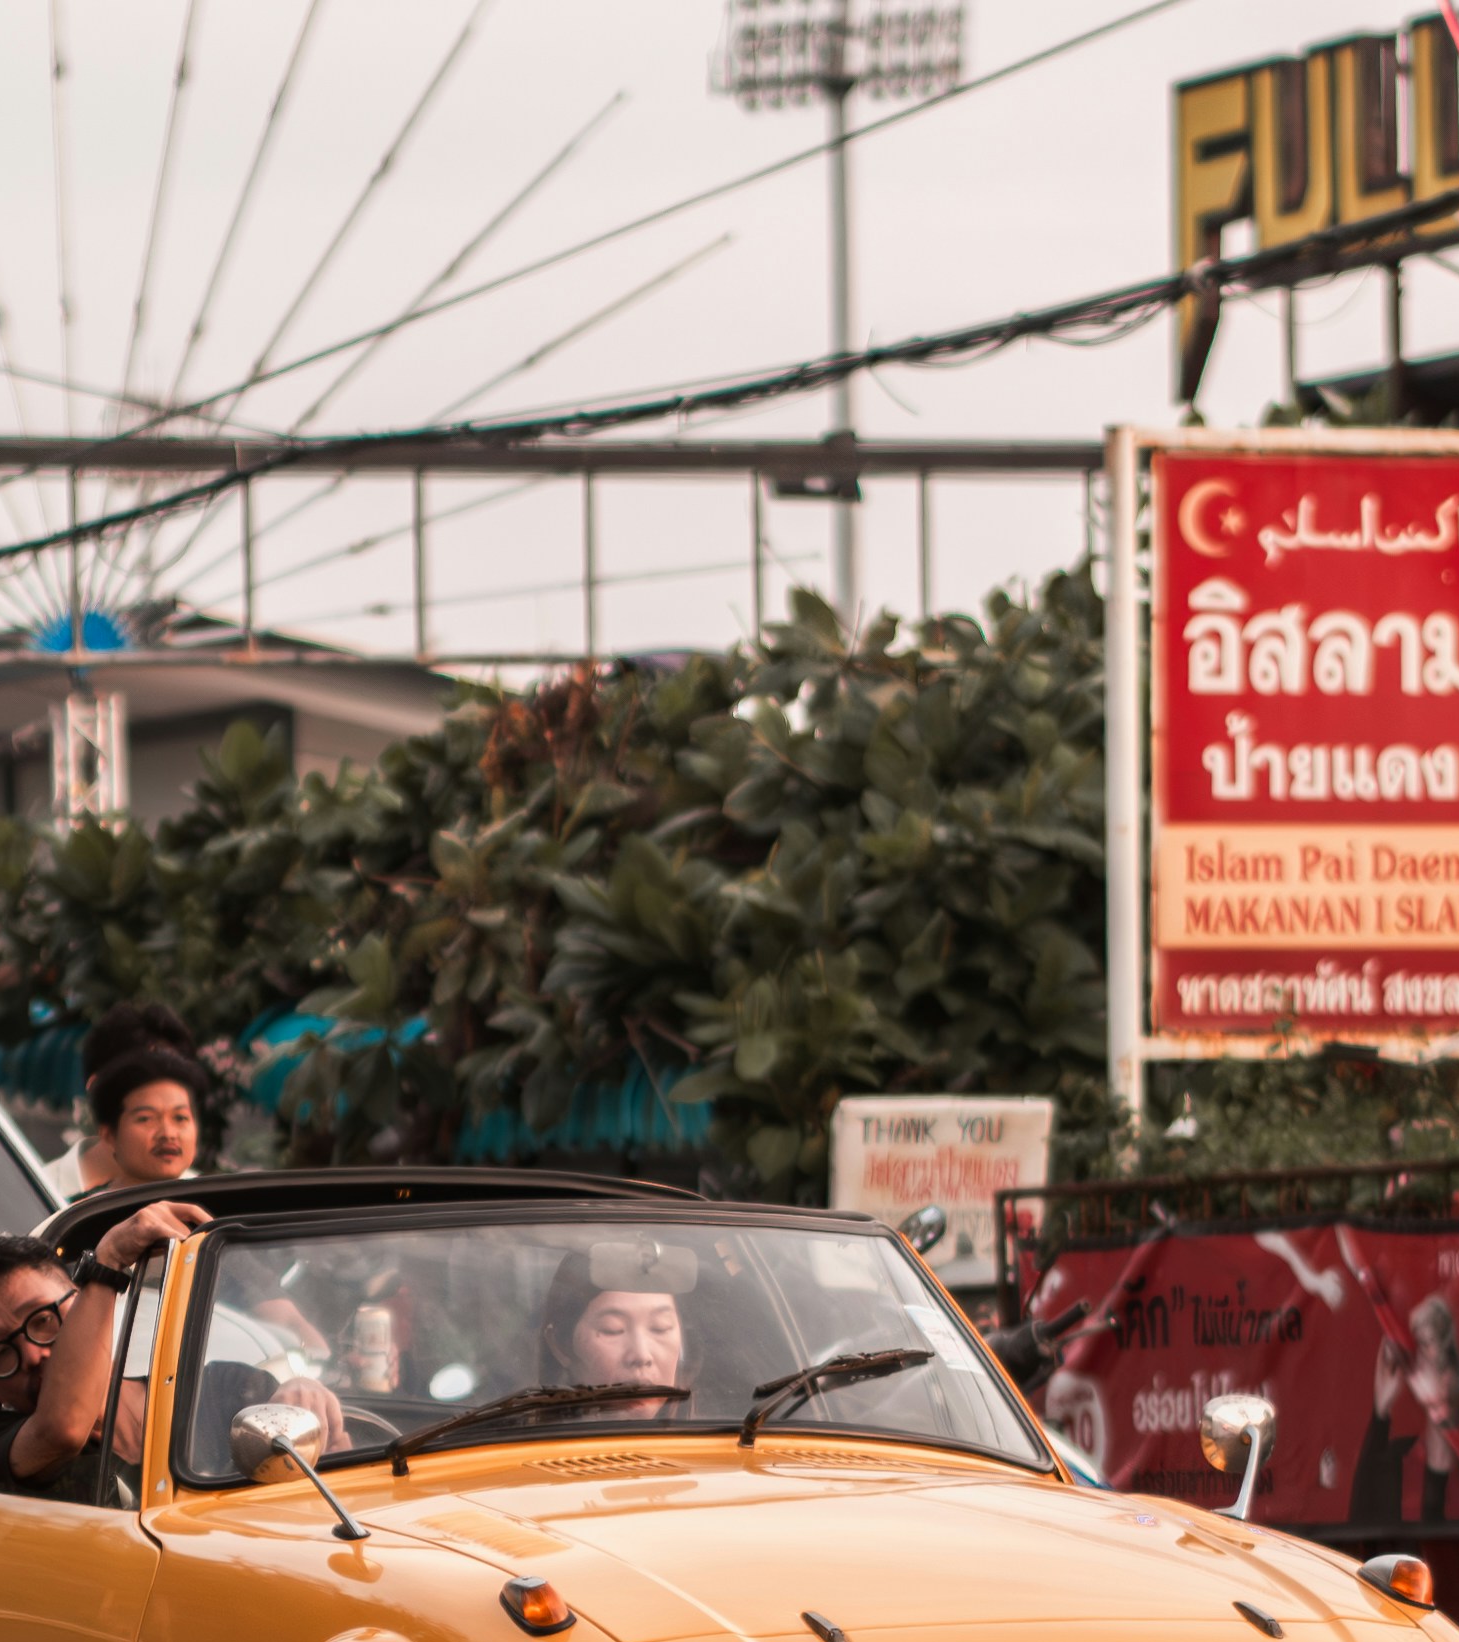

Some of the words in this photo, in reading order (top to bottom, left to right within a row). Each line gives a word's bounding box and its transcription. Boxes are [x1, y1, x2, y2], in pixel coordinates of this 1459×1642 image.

[1185, 842, 1283, 881] Islam
[1298, 842, 1355, 881] Pai
[1184, 896, 1362, 934] MAKANAN
[861, 1116, 937, 1145] THANK
[957, 1116, 1003, 1144] YOU
